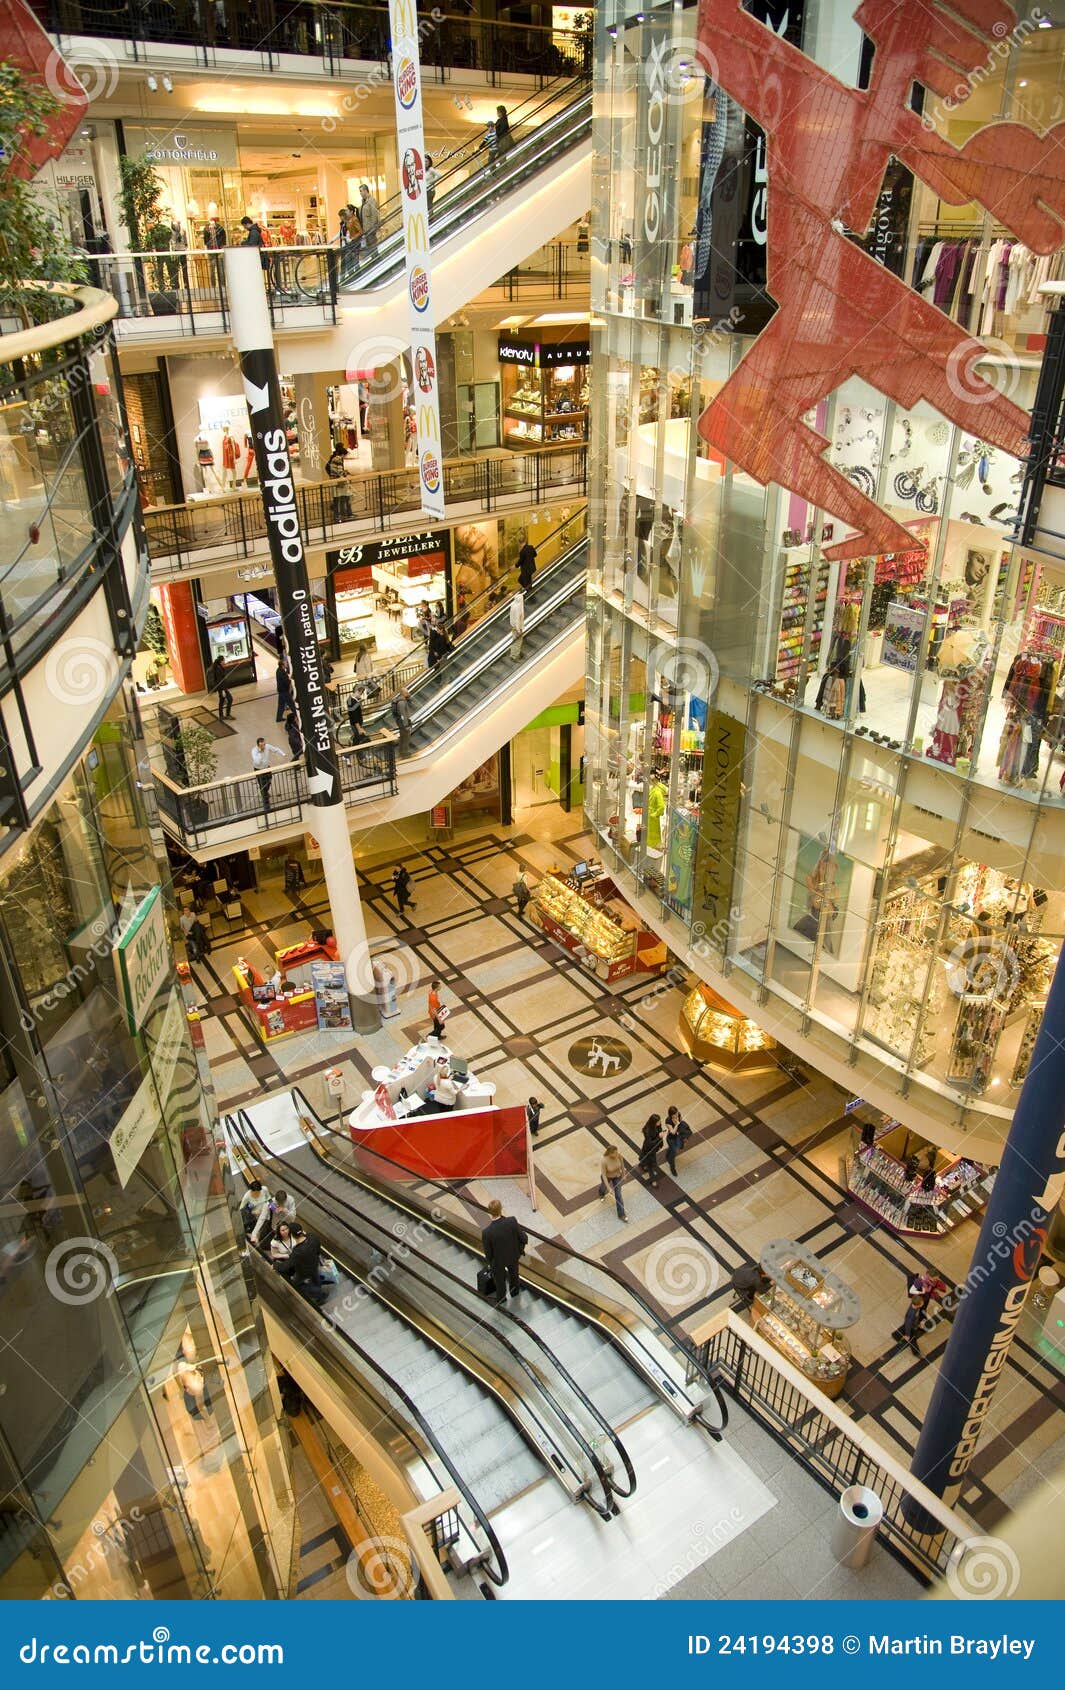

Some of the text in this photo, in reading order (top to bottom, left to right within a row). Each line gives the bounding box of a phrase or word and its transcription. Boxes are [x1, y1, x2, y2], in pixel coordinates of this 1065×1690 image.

[399, 72, 417, 100] KING
[645, 34, 665, 244] GEOX
[56, 175, 95, 186] HILFIGER
[412, 281, 429, 302] KING
[423, 465, 439, 482] KING
[264, 429, 303, 563] adidas
[377, 540, 441, 559] JEWELLERY
[292, 589, 306, 600] 0
[300, 603, 314, 637] patro
[311, 695, 326, 718] Na
[315, 719, 331, 752] Exit
[711, 727, 732, 833] MAISON
[949, 1281, 1033, 1477] SPORTISIMO
